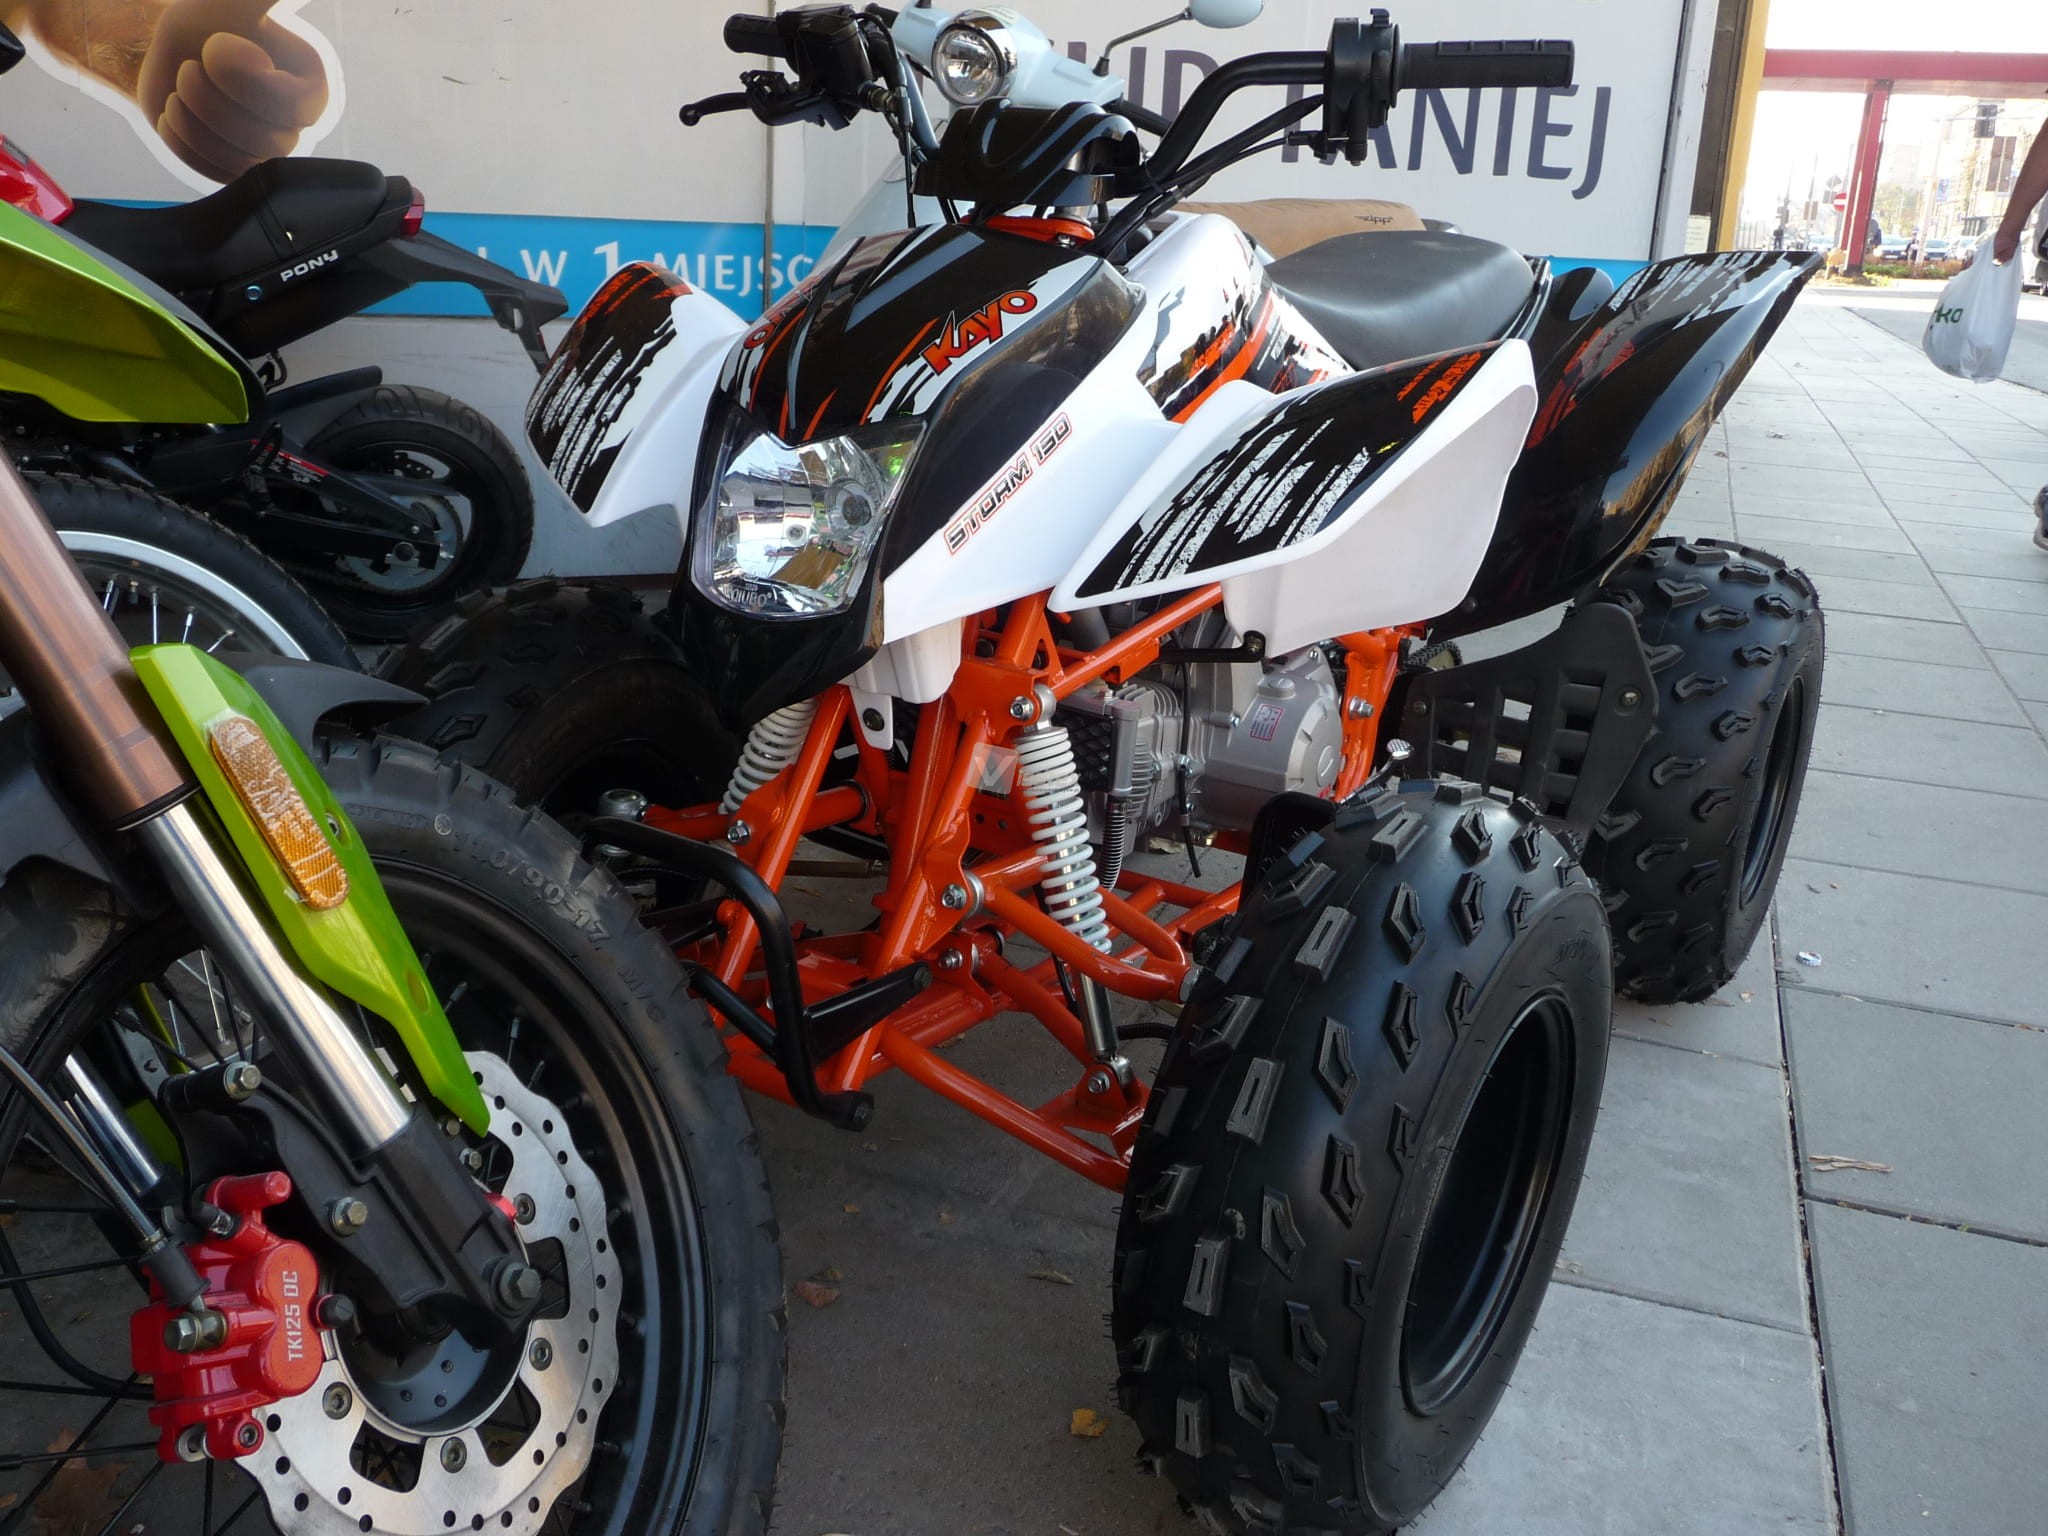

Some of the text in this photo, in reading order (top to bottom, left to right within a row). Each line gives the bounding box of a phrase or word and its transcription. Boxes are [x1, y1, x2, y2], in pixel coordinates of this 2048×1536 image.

[280, 249, 339, 282] PONY
[519, 249, 568, 287] W
[593, 241, 618, 277] 1
[920, 289, 1038, 376] KAYO
[945, 414, 1071, 553] STORM 150
[284, 1303, 304, 1362] TK125
